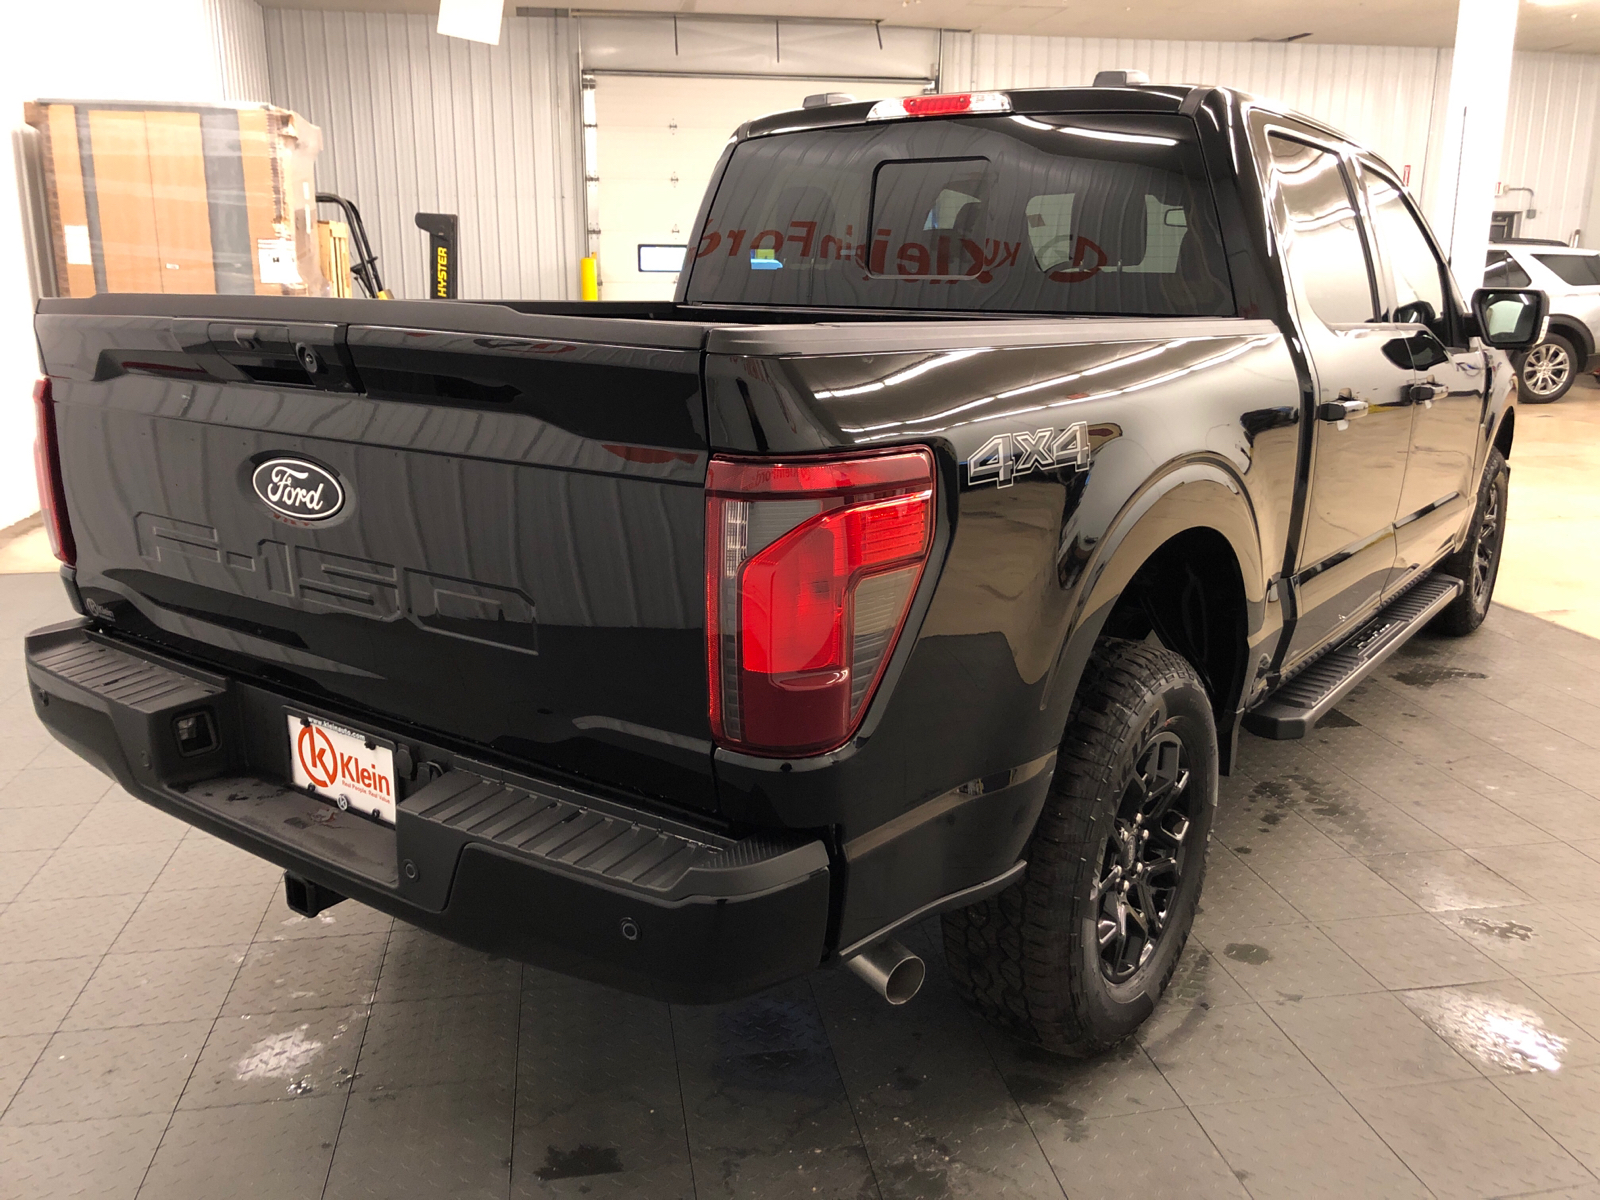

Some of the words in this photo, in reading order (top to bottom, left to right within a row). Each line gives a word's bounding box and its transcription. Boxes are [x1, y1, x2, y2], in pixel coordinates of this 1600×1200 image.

[437, 246, 448, 298] HYSTER
[267, 466, 324, 510] Ford
[340, 752, 391, 796] Klein
